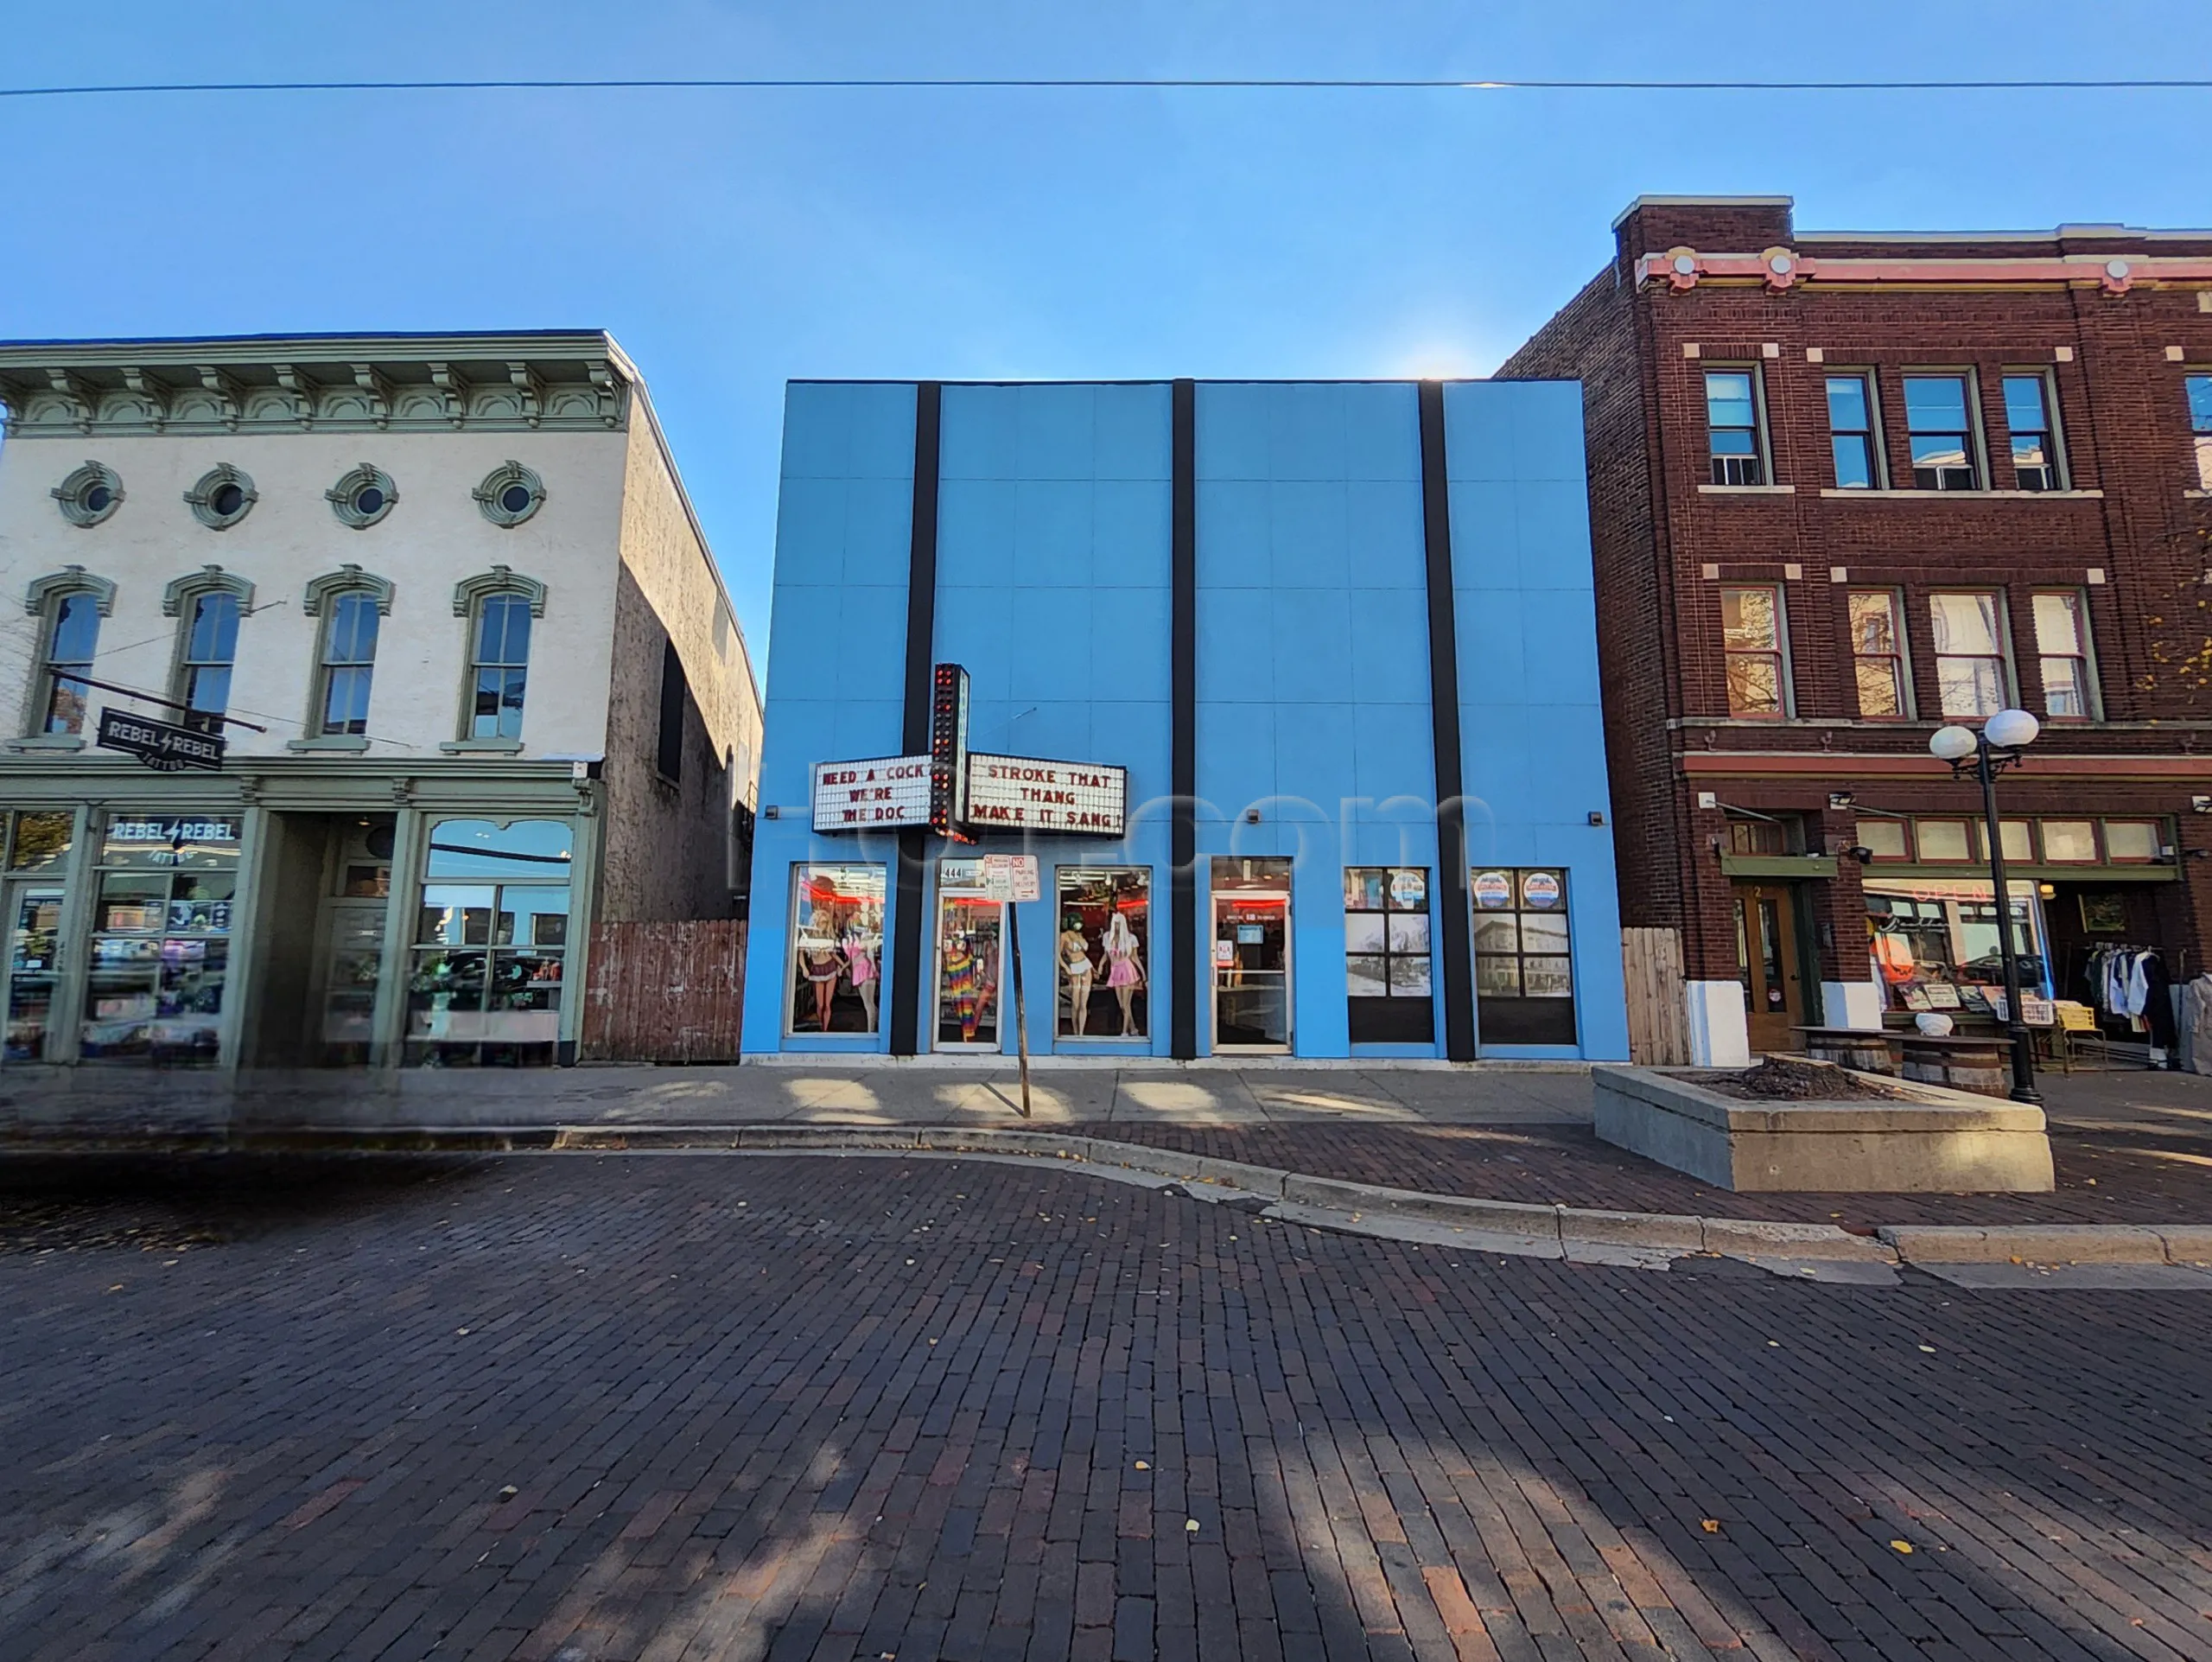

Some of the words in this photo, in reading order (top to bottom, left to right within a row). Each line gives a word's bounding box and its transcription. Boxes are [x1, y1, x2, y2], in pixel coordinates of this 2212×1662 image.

[107, 721, 160, 747] REBEL
[171, 736, 219, 760] REBEL
[143, 751, 185, 771] TATTOO
[823, 770, 857, 786] NEED
[866, 767, 875, 782] A
[988, 764, 1057, 783] STROKE
[1068, 772, 1112, 789] THAT
[849, 786, 893, 803] WE'RE
[1020, 787, 1076, 806] THANG
[842, 808, 867, 823] THE
[874, 805, 906, 821] DOC
[972, 804, 1026, 821] MAKE
[1039, 809, 1054, 824] IT
[111, 823, 167, 840] REBEL
[180, 823, 236, 840] REBEL
[1013, 858, 1024, 868] NO
[944, 867, 962, 878] 444
[1754, 886, 1762, 897] 2
[1912, 884, 1988, 901] OPEN
